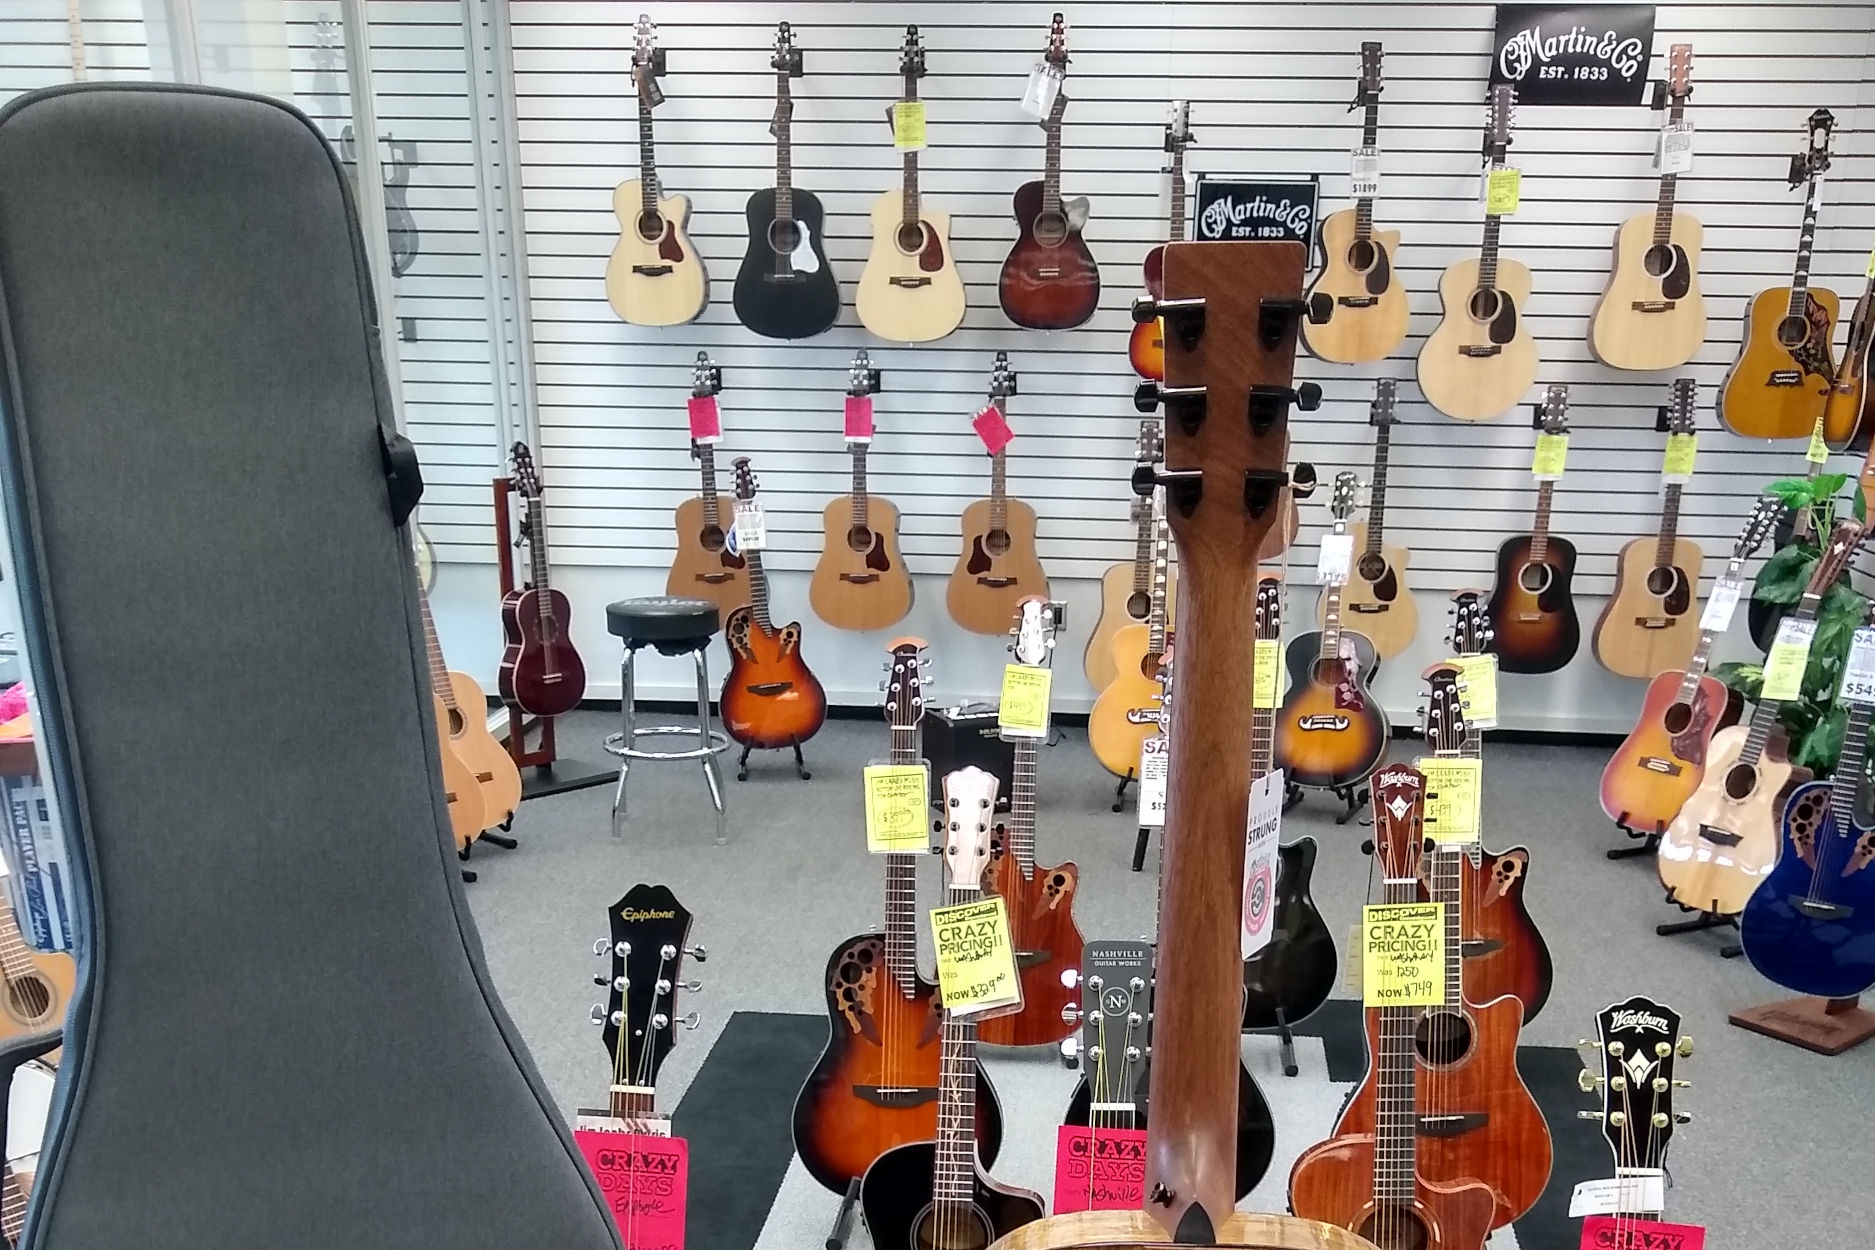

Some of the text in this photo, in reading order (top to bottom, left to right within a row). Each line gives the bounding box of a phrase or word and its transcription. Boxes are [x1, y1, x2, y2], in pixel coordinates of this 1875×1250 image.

[1539, 66, 1609, 80] EST. 1833
[1231, 226, 1285, 237] EST. 1833
[1855, 633, 1875, 645] SA
[1846, 683, 1875, 696] $54
[1380, 771, 1419, 788] Washburn
[1248, 817, 1277, 846] STRUNG
[18, 828, 39, 873] PLAYER
[621, 906, 675, 923] Epiphone
[939, 919, 998, 942] CRAZY
[1370, 924, 1435, 940] CRAZY
[939, 934, 1003, 956] PRICING!!
[1369, 939, 1438, 953] PRICING!!
[1092, 950, 1144, 958] NASHVILLE
[946, 989, 969, 1001] NOW
[1377, 980, 1433, 998] NOW $749
[1611, 1009, 1669, 1031] Washburn
[596, 1149, 679, 1175] CRAZY
[1067, 1158, 1145, 1183] DAYS
[597, 1172, 673, 1196] DAYS
